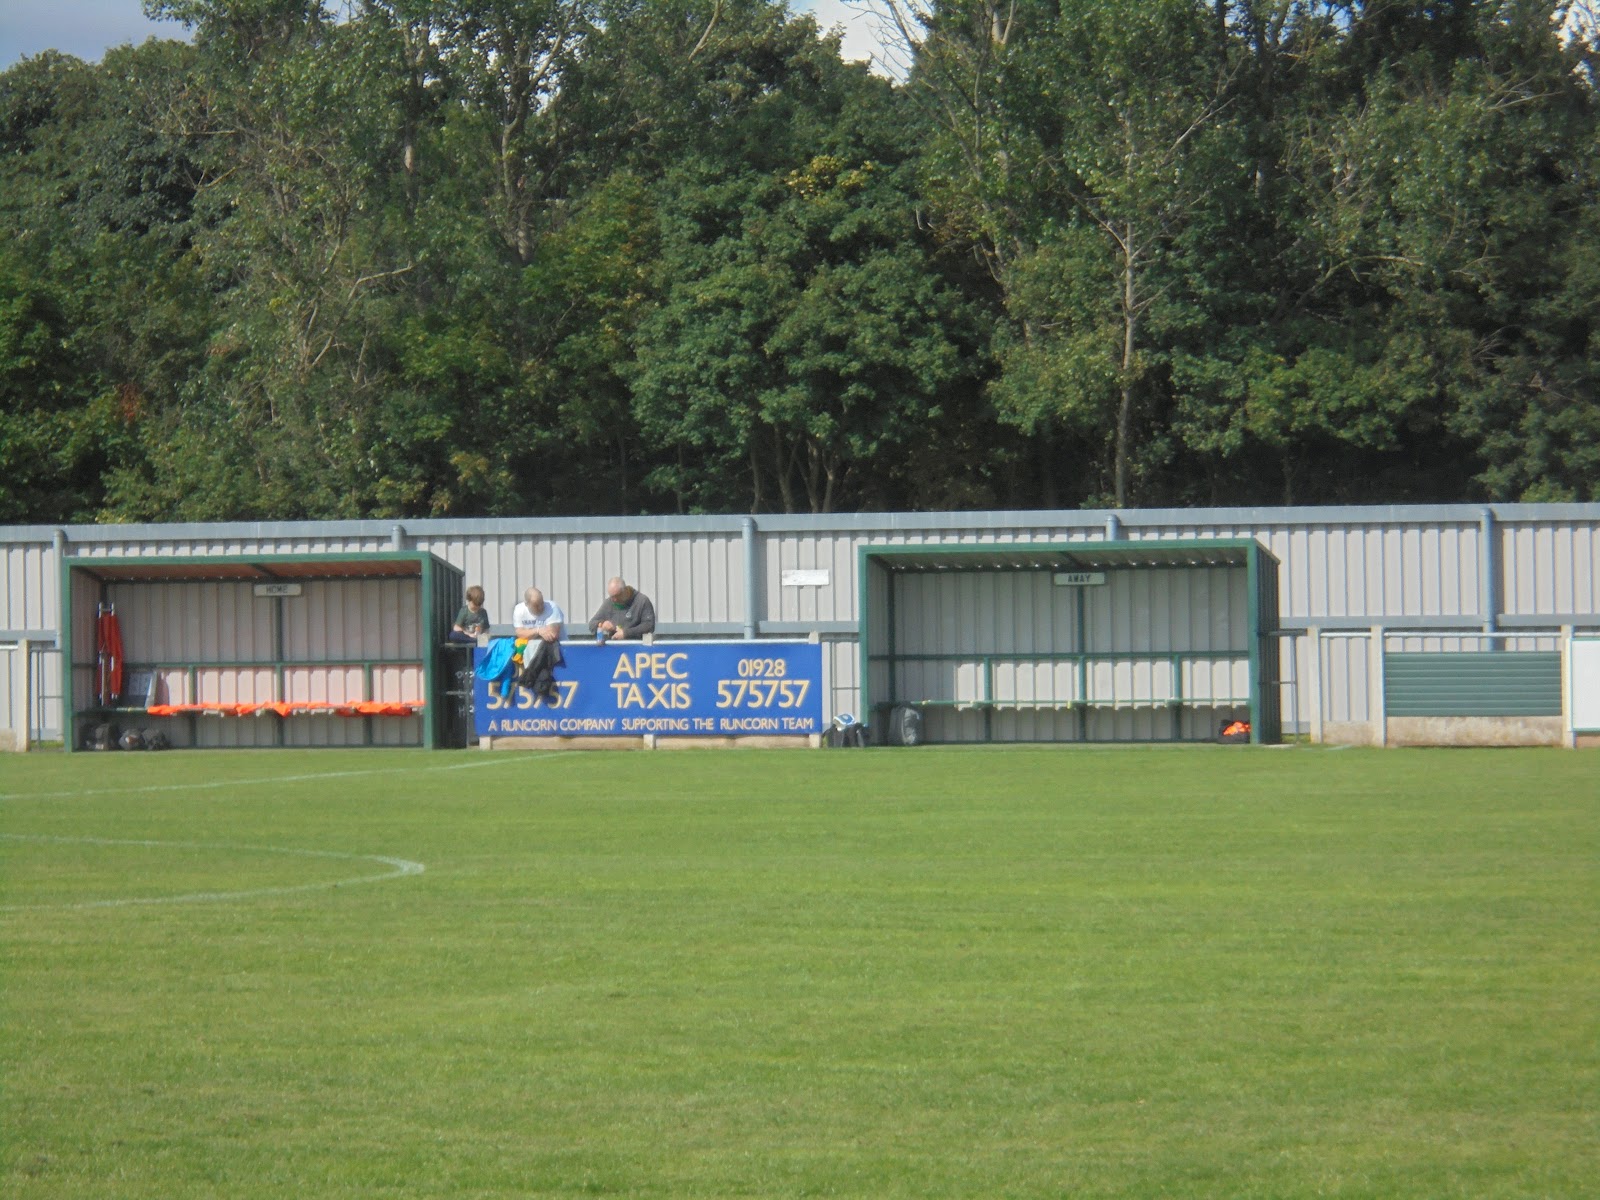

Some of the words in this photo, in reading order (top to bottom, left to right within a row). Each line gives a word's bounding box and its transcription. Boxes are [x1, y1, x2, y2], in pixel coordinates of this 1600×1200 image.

[1067, 574, 1091, 583] AWAY
[266, 584, 288, 594] HOME
[612, 652, 689, 679] APEC
[737, 658, 786, 677] 01928
[609, 682, 692, 709] TAXIS
[715, 679, 811, 708] 575757
[488, 720, 498, 732] A
[501, 719, 557, 732] RUNCORN
[559, 718, 615, 731] COMPANY
[621, 718, 689, 731] SUPPORTING
[692, 718, 714, 730] THE
[720, 717, 778, 730] RUNCORN
[781, 717, 813, 730] TEAM
